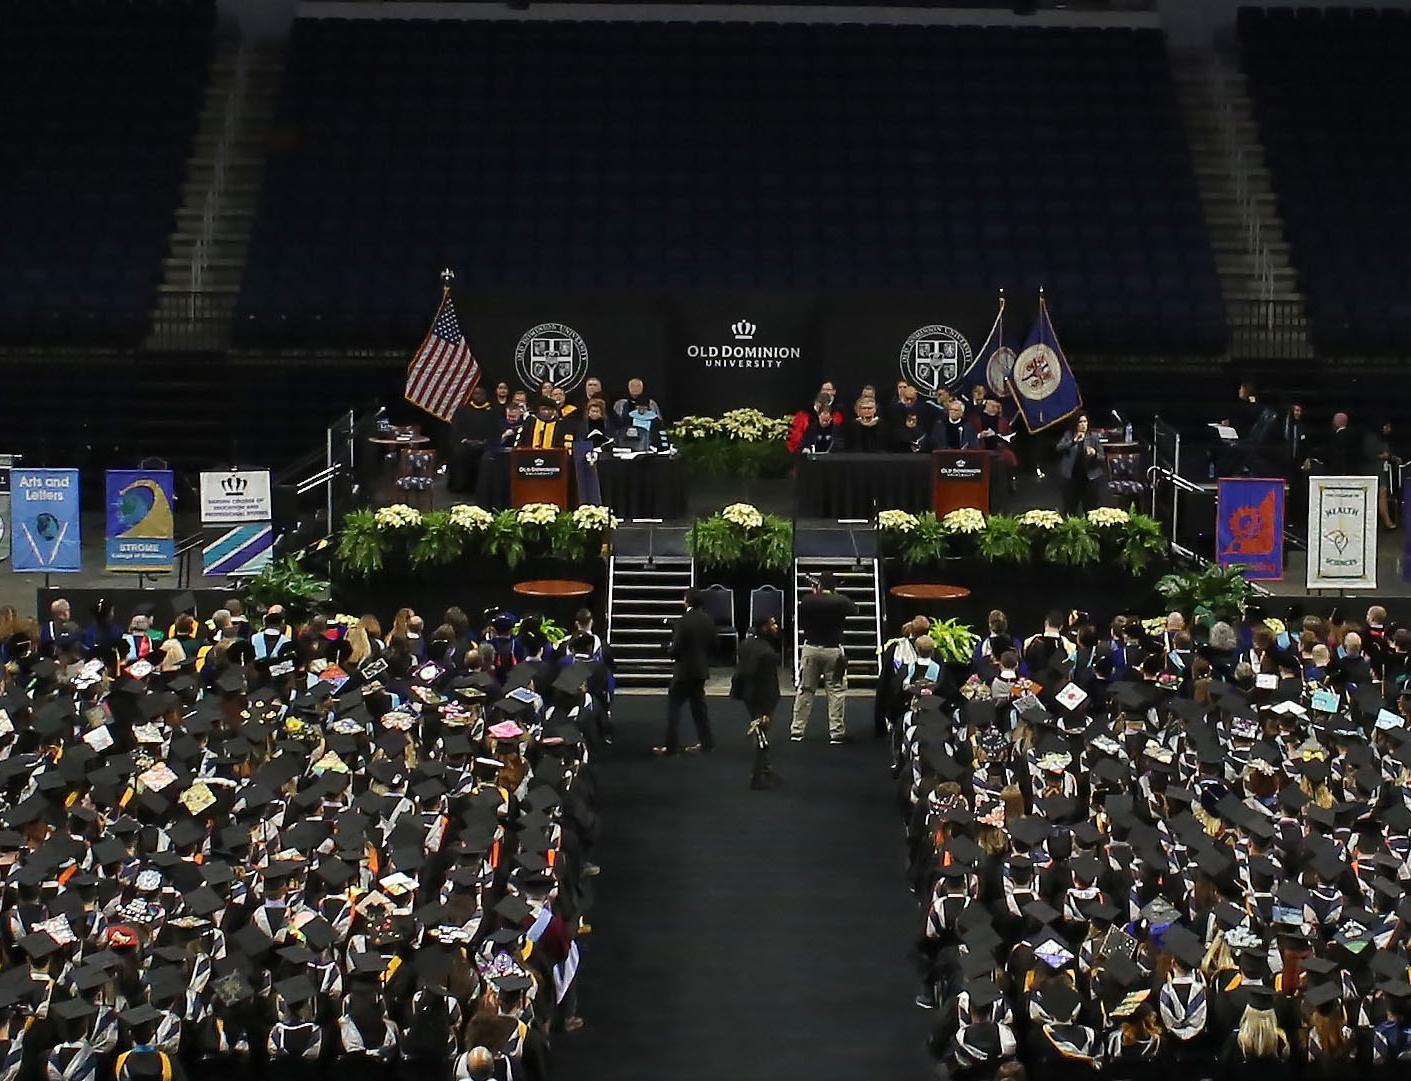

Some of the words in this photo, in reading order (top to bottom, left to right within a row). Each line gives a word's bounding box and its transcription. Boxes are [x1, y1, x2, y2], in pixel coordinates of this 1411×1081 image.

[687, 345, 719, 358] OLD
[721, 345, 800, 358] DOMINION
[705, 360, 782, 368] UNIVERSITY
[19, 476, 42, 488] Arts
[45, 476, 69, 488] and
[26, 489, 64, 501] Letters
[1325, 506, 1359, 518] HEALTH
